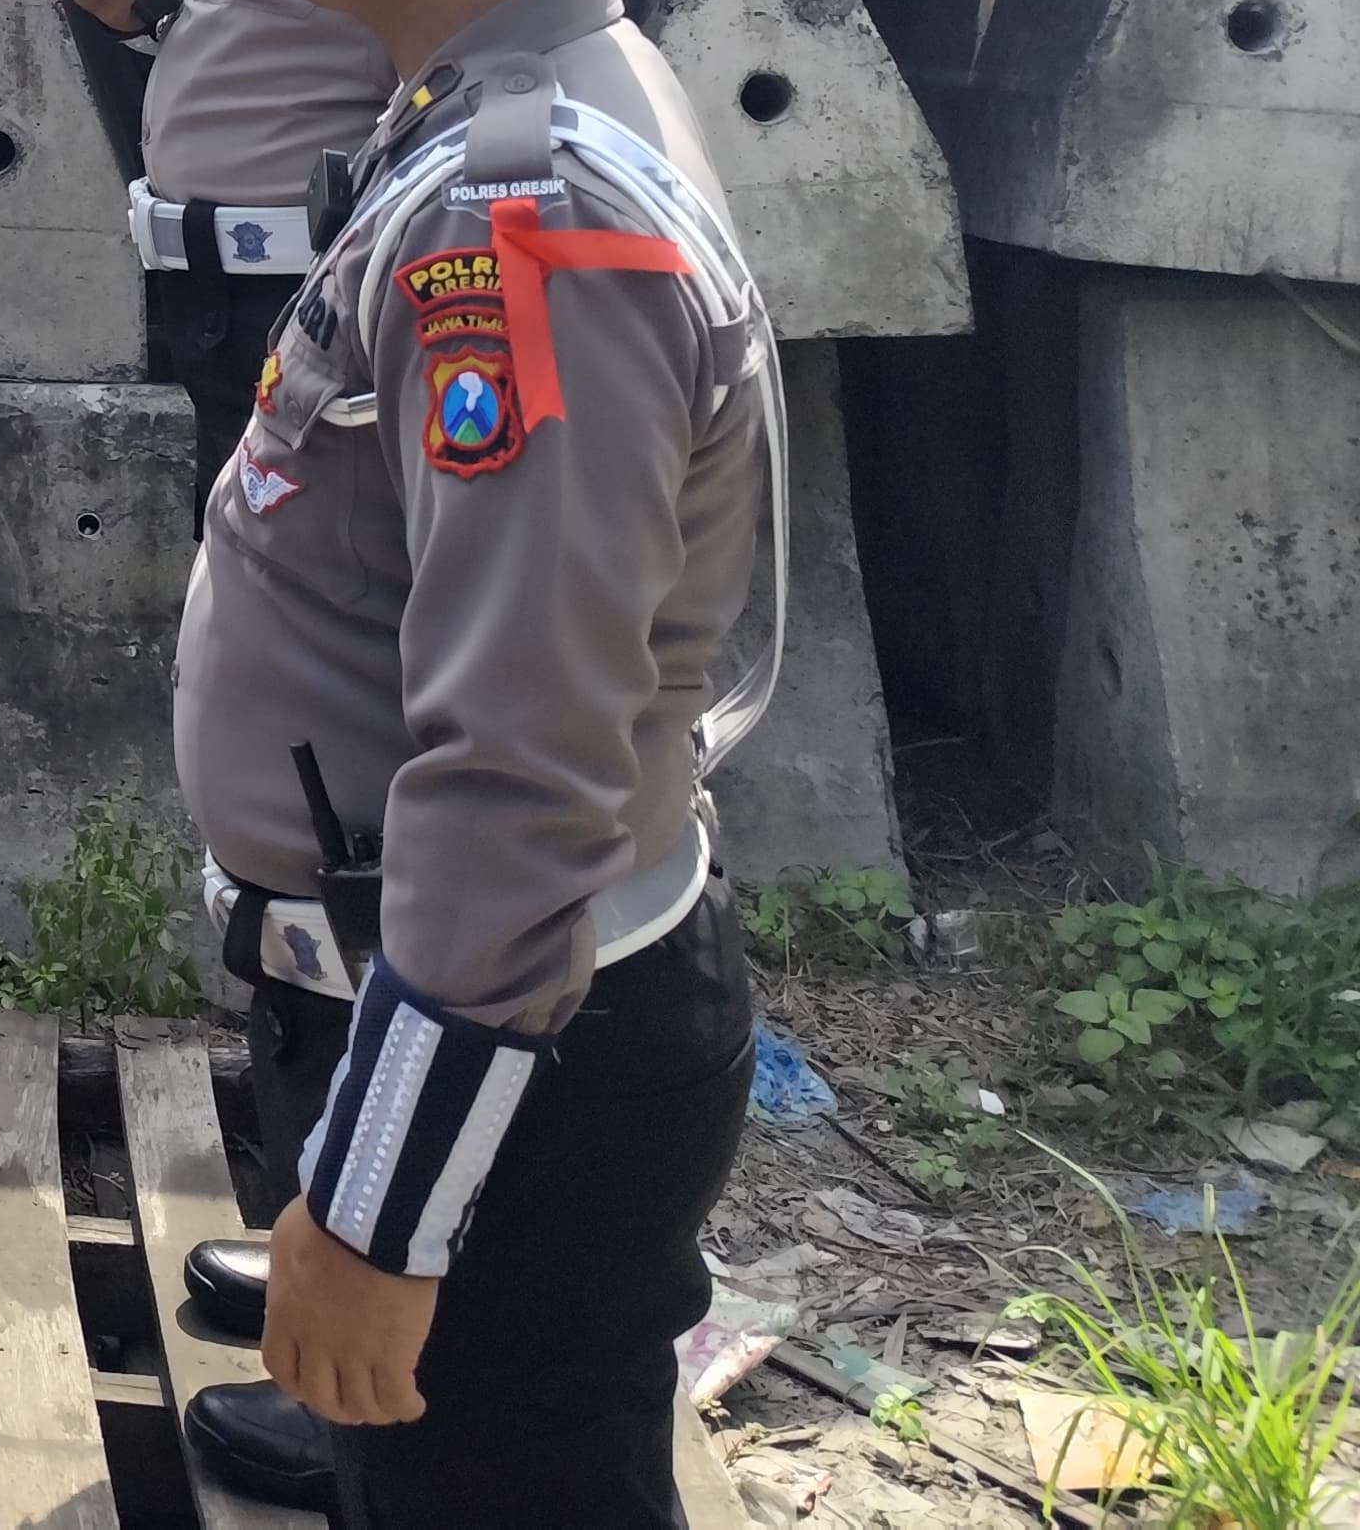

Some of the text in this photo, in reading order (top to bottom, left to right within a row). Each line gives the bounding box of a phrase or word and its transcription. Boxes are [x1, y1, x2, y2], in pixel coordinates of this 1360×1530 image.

[450, 179, 565, 201] POLRES GRESIK
[409, 256, 500, 291] POLR
[430, 275, 501, 298] GRESI
